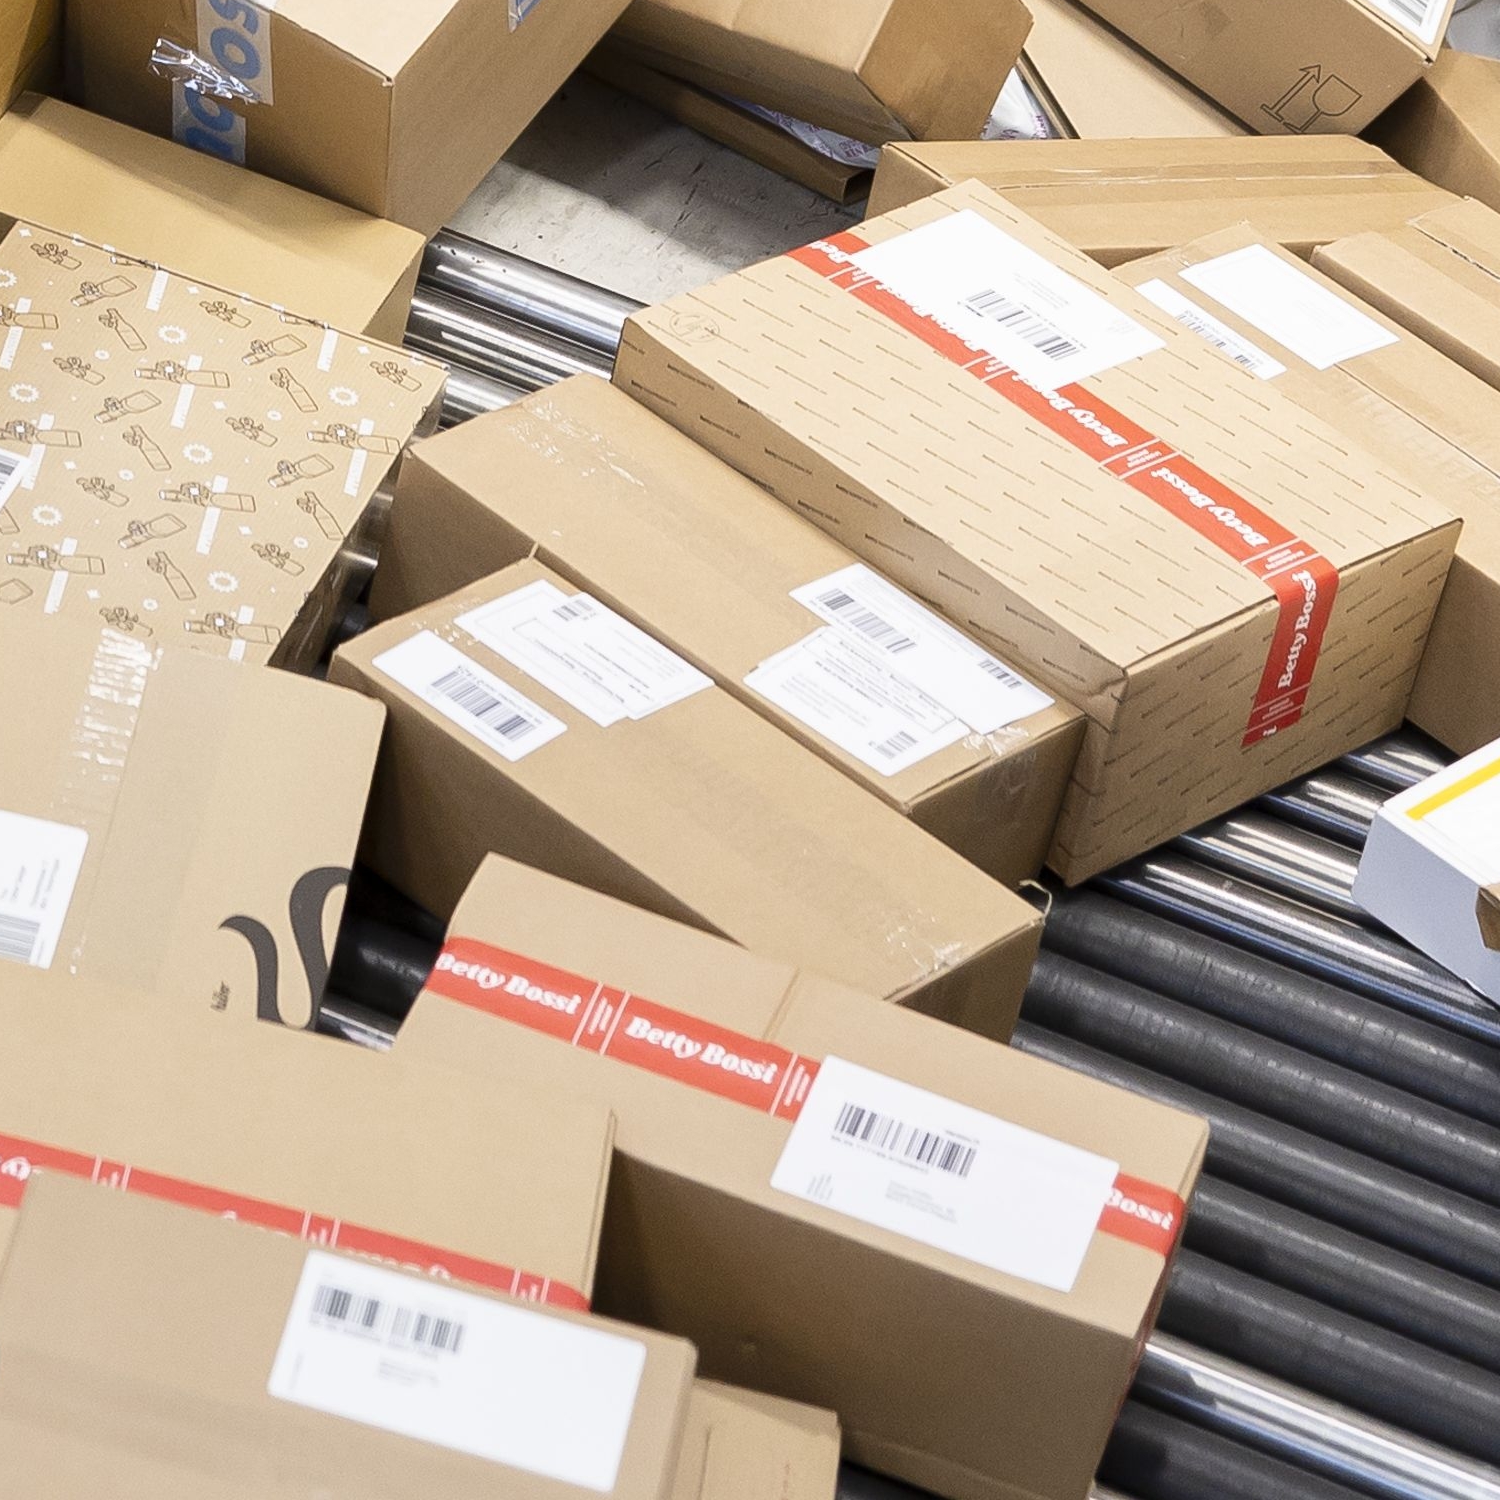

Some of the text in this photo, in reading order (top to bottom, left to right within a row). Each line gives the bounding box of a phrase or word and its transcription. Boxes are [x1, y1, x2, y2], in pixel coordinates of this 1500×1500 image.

[1150, 466, 1270, 548] Bossi Betty
[1291, 569, 1318, 631] Bossi
[1277, 631, 1308, 690] Betty
[436, 952, 582, 1015] Betty Bossi
[625, 1016, 704, 1060] Betty
[700, 1042, 779, 1086] Bossi
